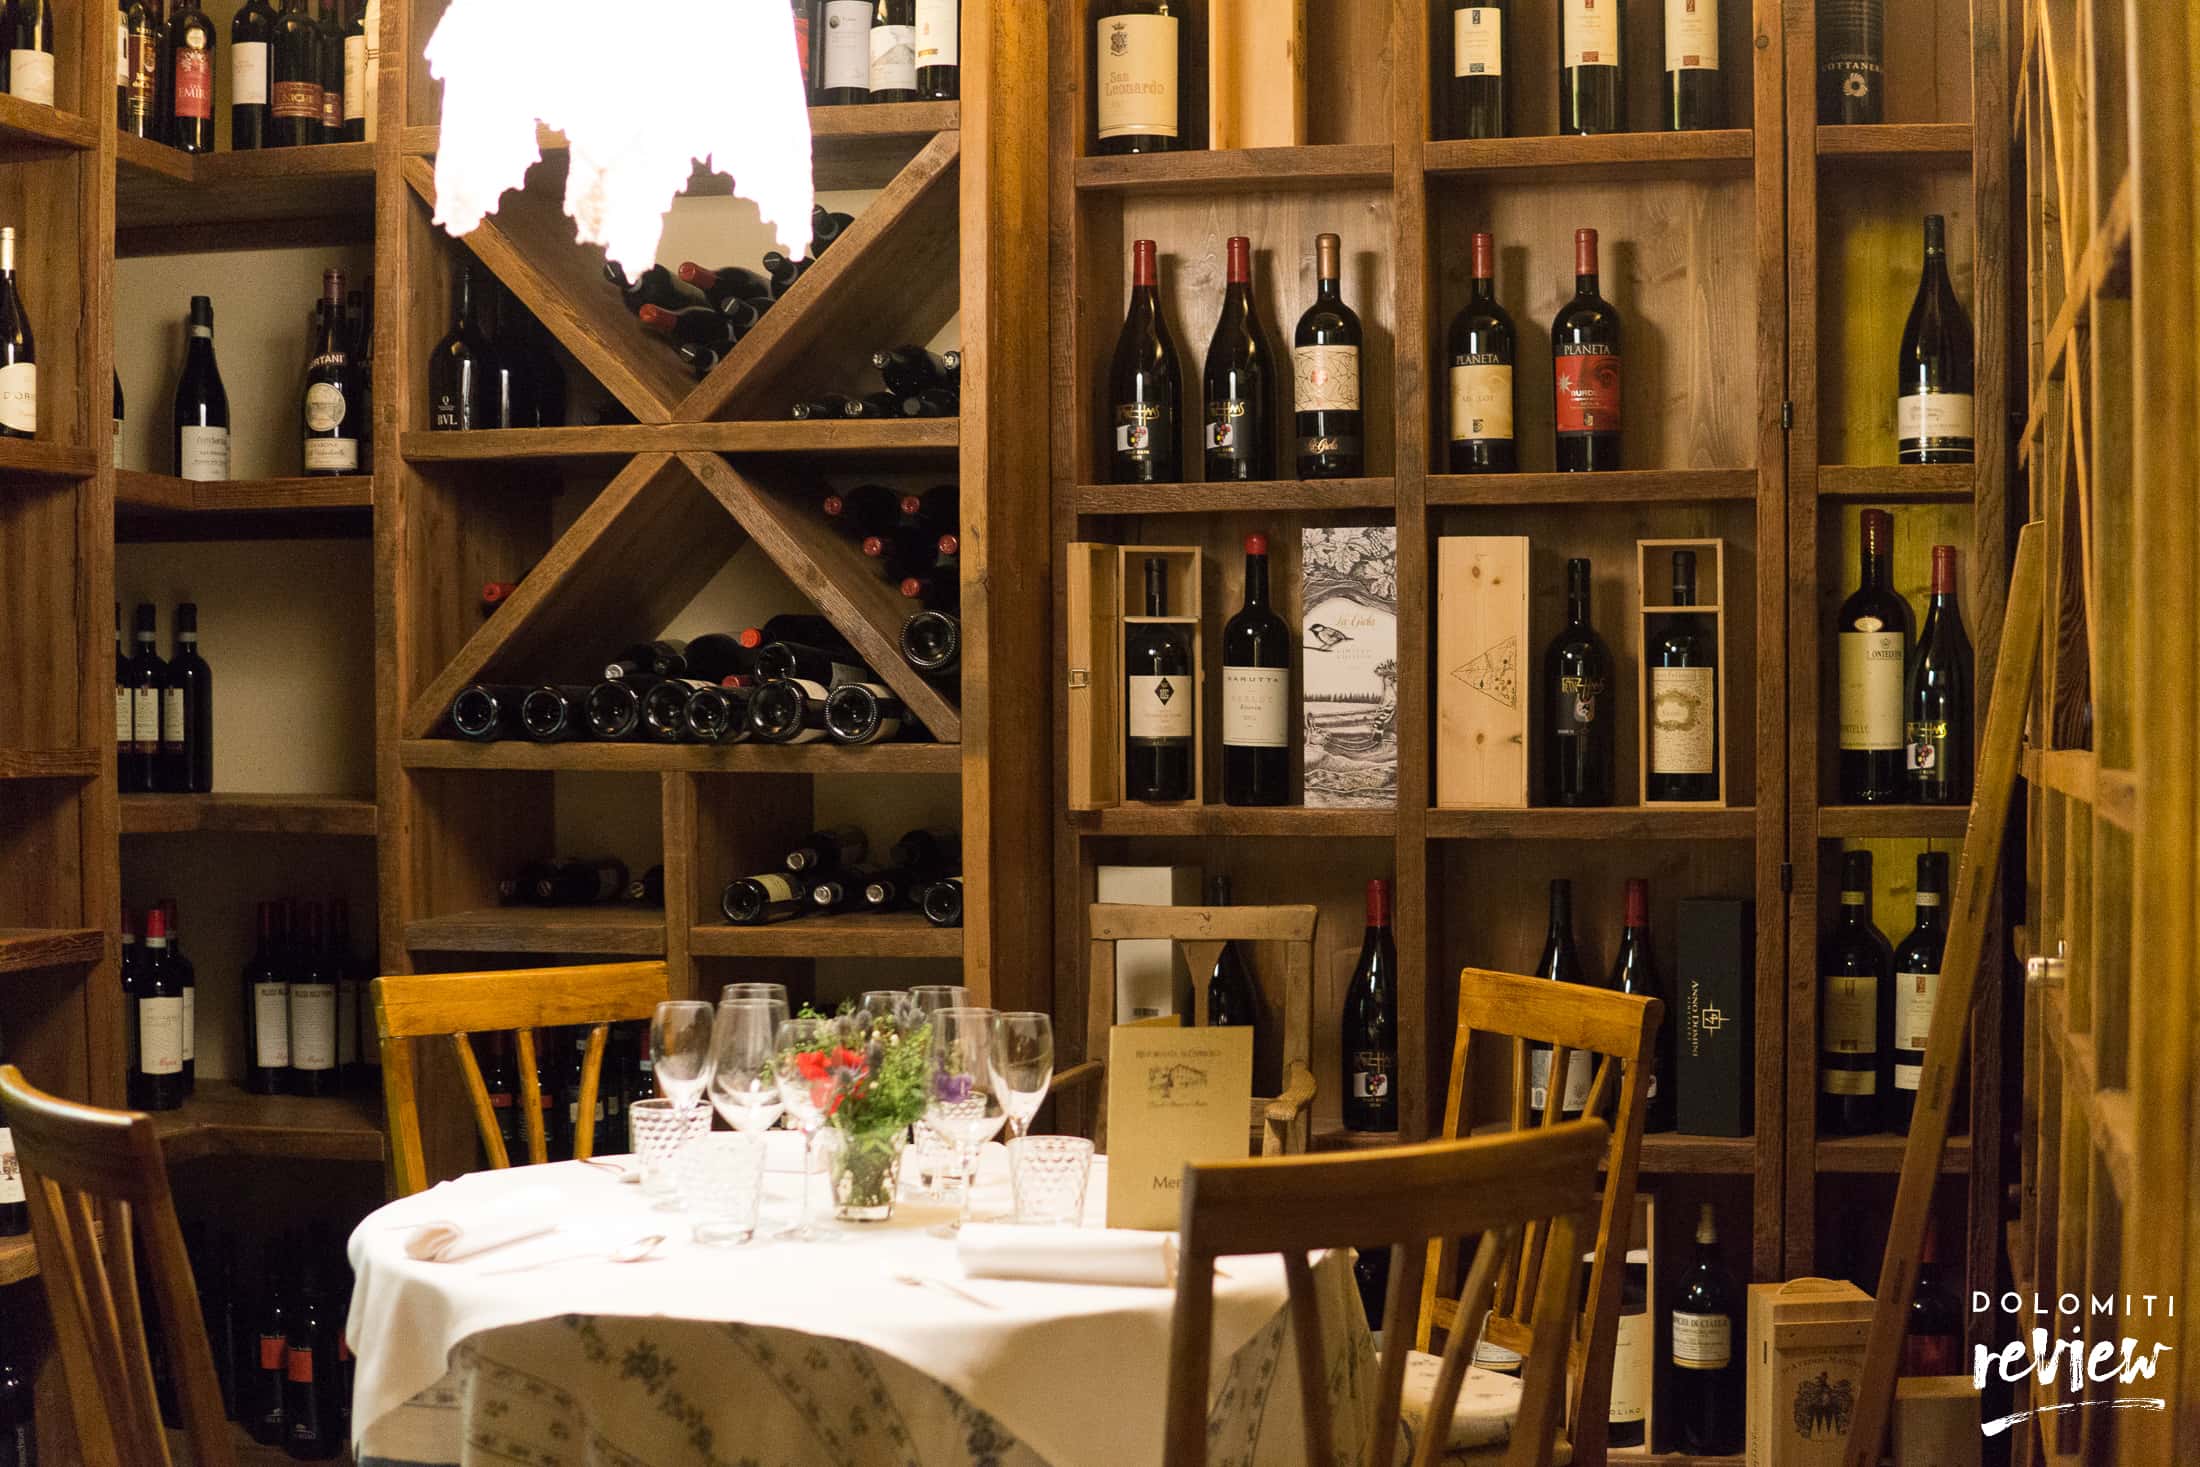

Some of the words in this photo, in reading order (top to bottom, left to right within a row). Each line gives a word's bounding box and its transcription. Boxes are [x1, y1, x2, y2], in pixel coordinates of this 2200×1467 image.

[1105, 81, 1165, 96] Leonardo
[1563, 344, 1610, 355] PLANETA
[1456, 354, 1500, 365] PLANETA
